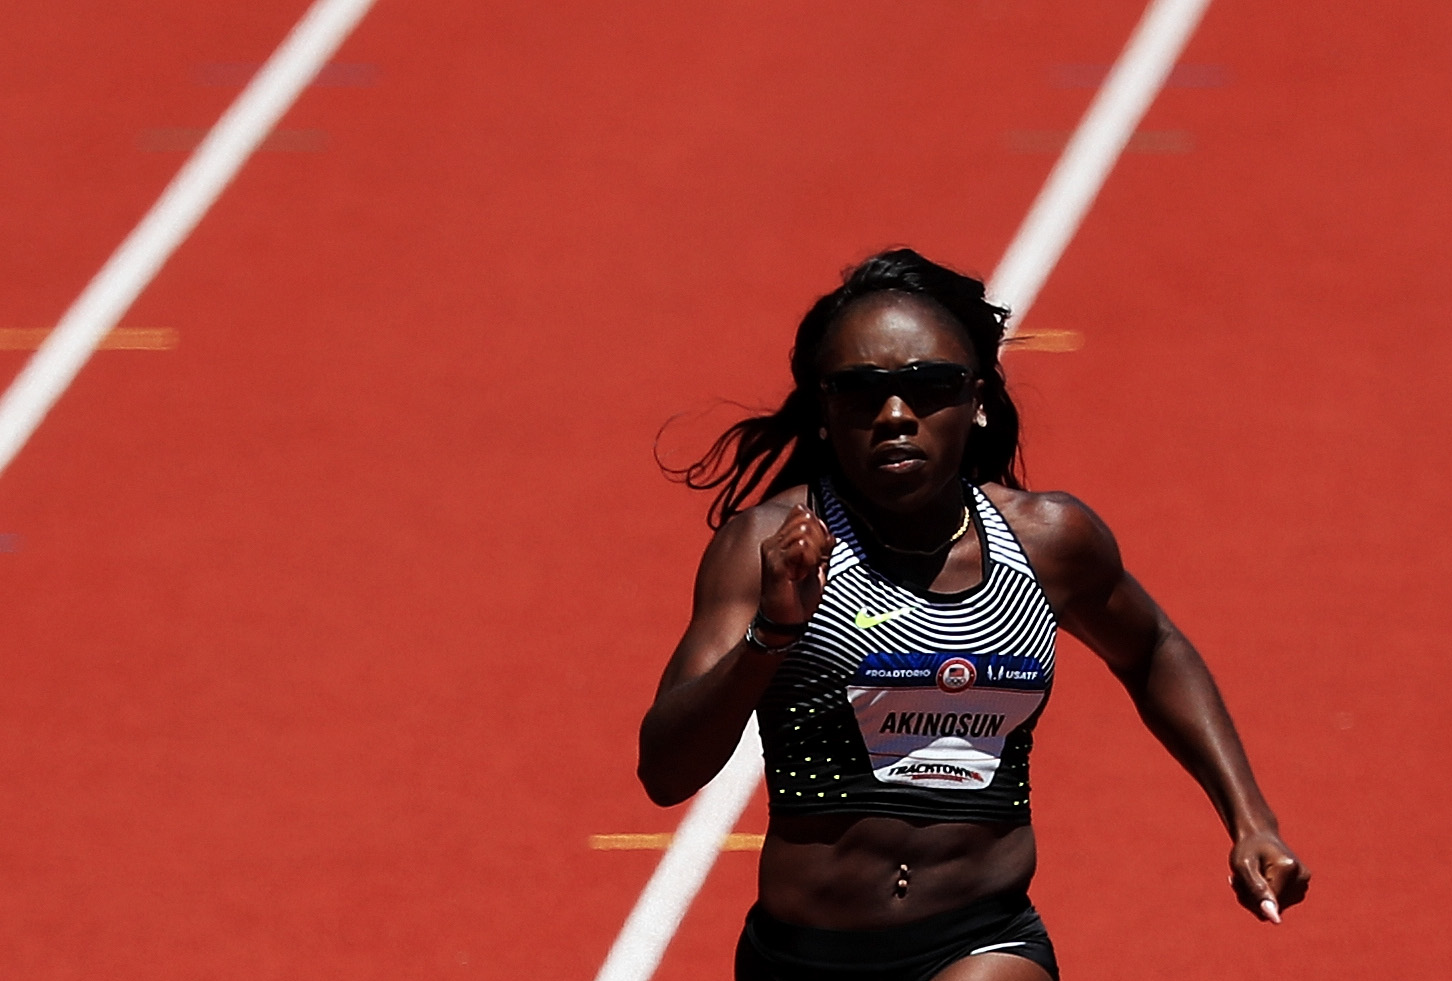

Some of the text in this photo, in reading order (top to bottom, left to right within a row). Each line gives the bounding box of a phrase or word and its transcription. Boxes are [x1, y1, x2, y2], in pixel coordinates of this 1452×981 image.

[865, 669, 932, 678] #ROADTORIO
[1005, 670, 1038, 680] USATF
[879, 712, 1005, 738] AKINOSUN
